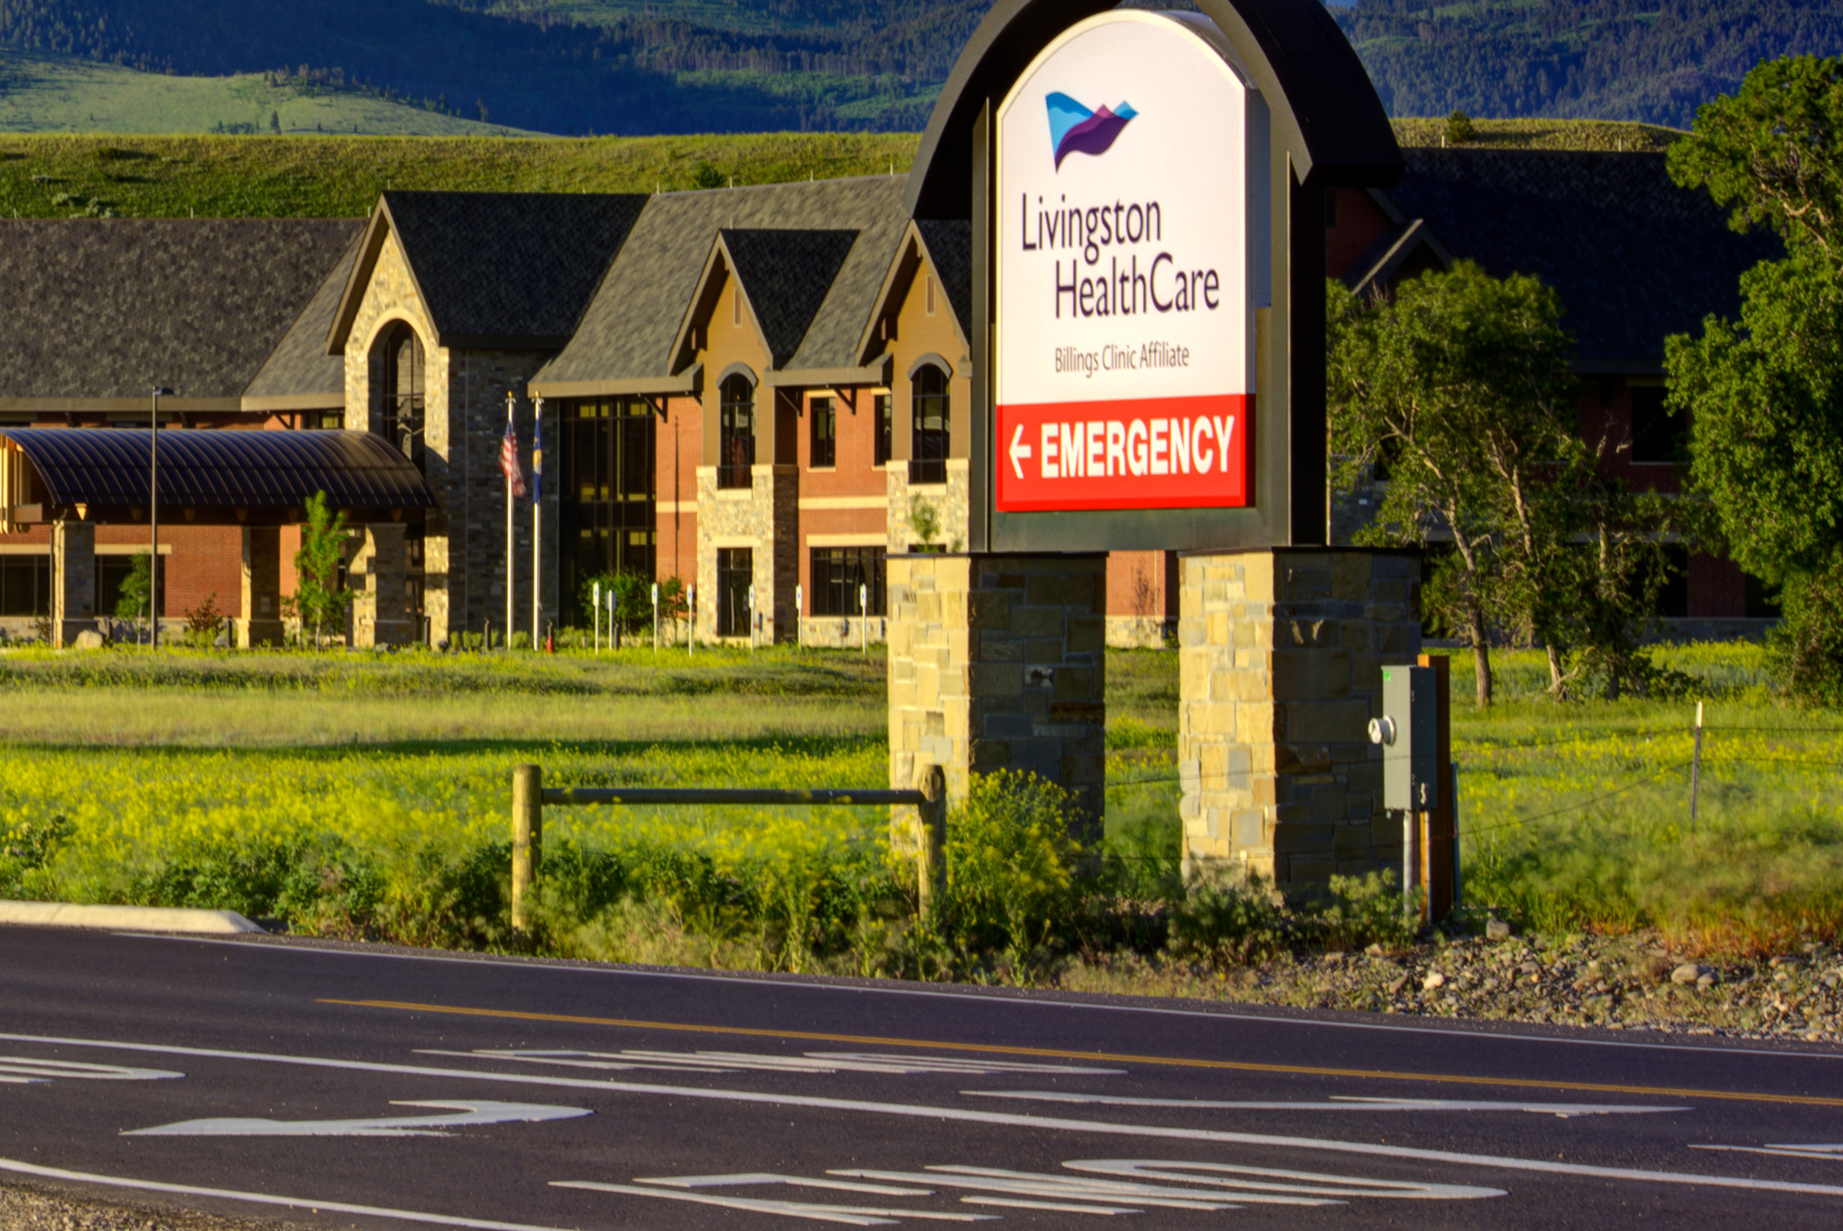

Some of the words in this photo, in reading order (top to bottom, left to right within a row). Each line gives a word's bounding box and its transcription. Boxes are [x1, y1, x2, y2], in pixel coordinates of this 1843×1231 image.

[1022, 192, 1161, 265] Livingston
[1055, 252, 1220, 319] HealthCare
[1055, 346, 1099, 378] Billings
[1102, 344, 1137, 371] Clinic
[1139, 341, 1190, 369] Affiliate
[1041, 415, 1235, 479] EMERGENCY
[548, 1159, 1509, 1226] ONLY
